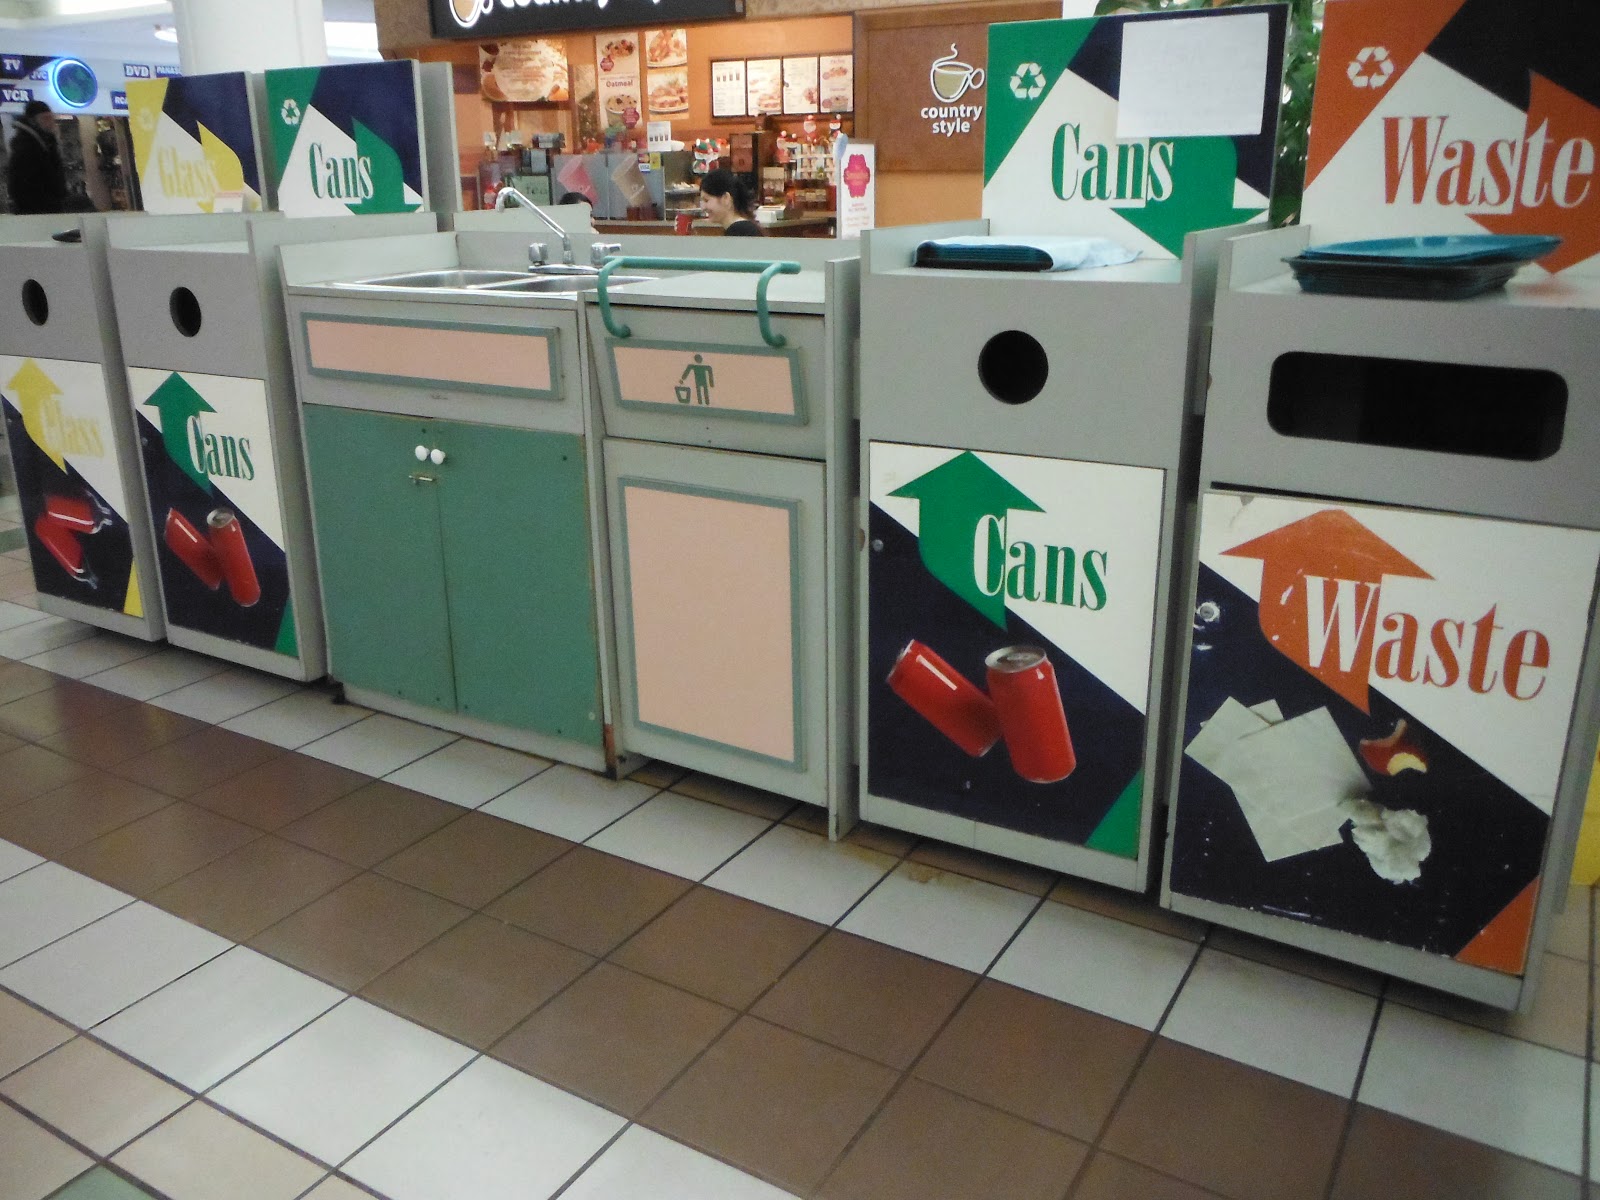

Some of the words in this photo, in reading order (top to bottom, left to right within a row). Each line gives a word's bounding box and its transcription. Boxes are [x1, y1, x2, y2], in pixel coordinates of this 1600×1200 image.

[4, 59, 21, 71] TV
[125, 65, 149, 77] DVD
[156, 65, 181, 75] PANAS
[31, 71, 48, 80] JVC
[605, 79, 634, 88] Oatmeal
[2, 89, 30, 102] VCR
[114, 96, 128, 105] RC
[920, 104, 983, 120] country
[932, 117, 970, 137] style
[1051, 122, 1175, 203] Cans
[1381, 115, 1595, 209] Waste
[309, 142, 374, 200] Cans
[186, 414, 255, 481] Cans
[972, 513, 1109, 612] Cans
[1302, 573, 1551, 702] Waste
